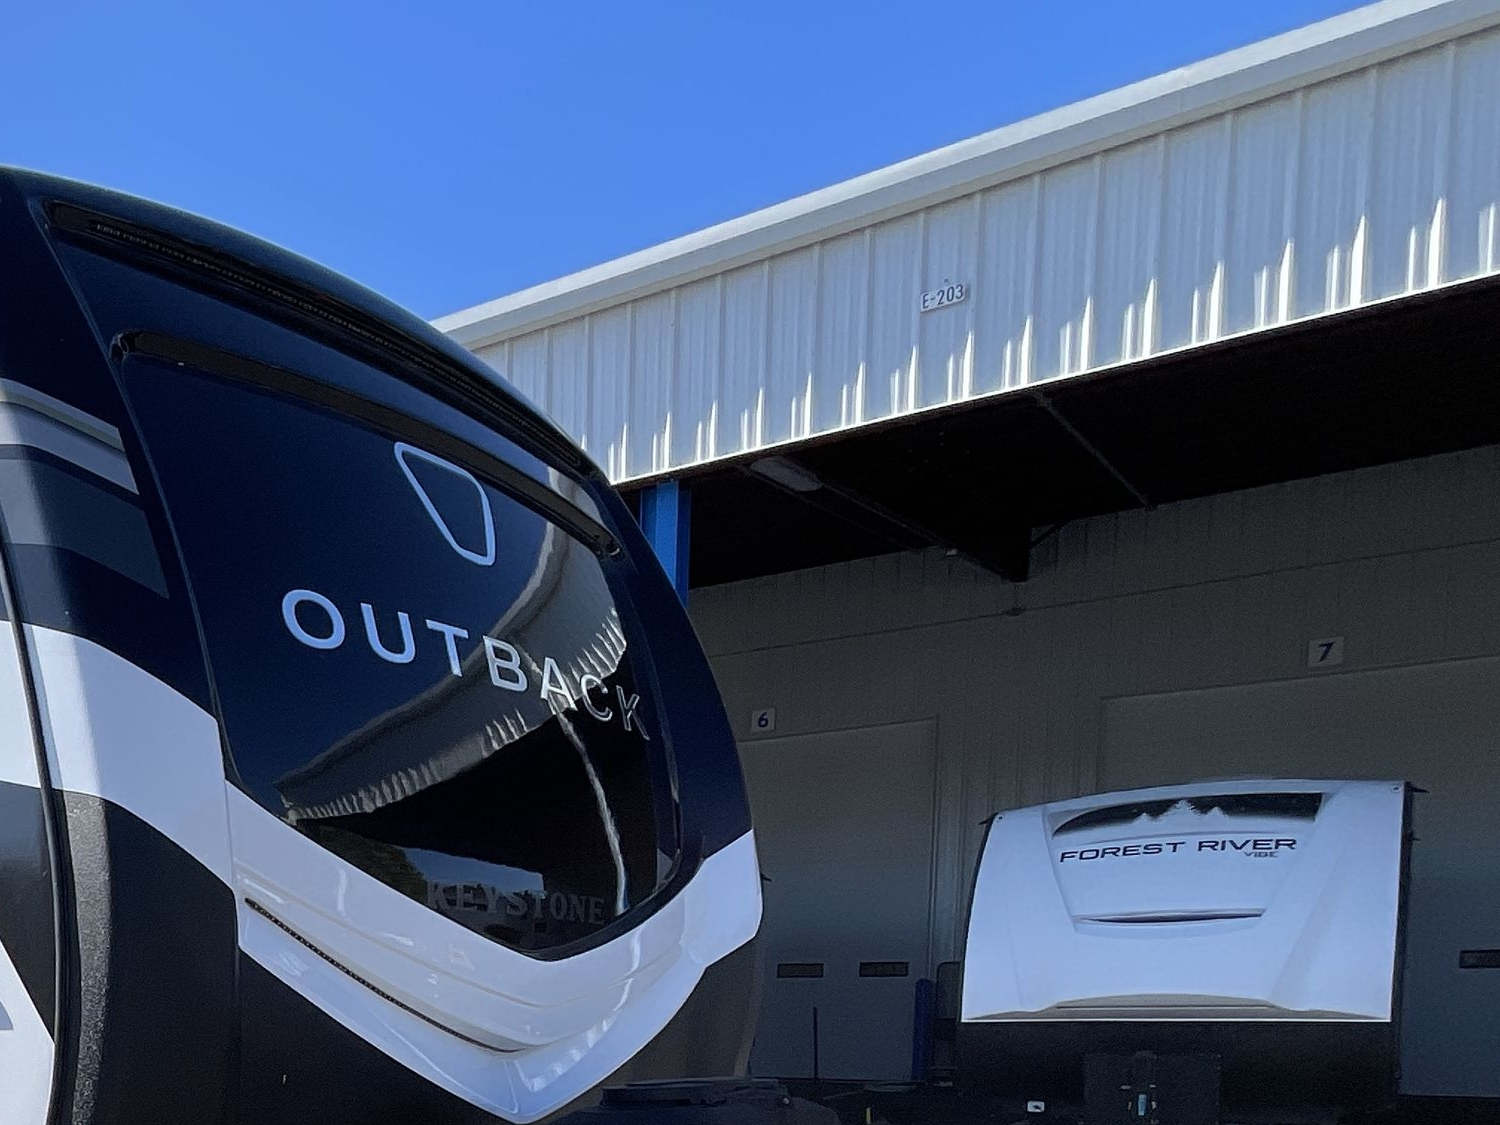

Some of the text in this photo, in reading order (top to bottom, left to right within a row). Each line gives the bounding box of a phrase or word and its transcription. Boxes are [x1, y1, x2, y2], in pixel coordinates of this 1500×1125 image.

[922, 284, 964, 310] E-203
[1317, 642, 1334, 662] 7
[282, 589, 650, 741] OUTBACK
[758, 711, 769, 728] 6
[1060, 838, 1297, 863] FOREST RIVER
[427, 882, 604, 924] KEYSTONE
